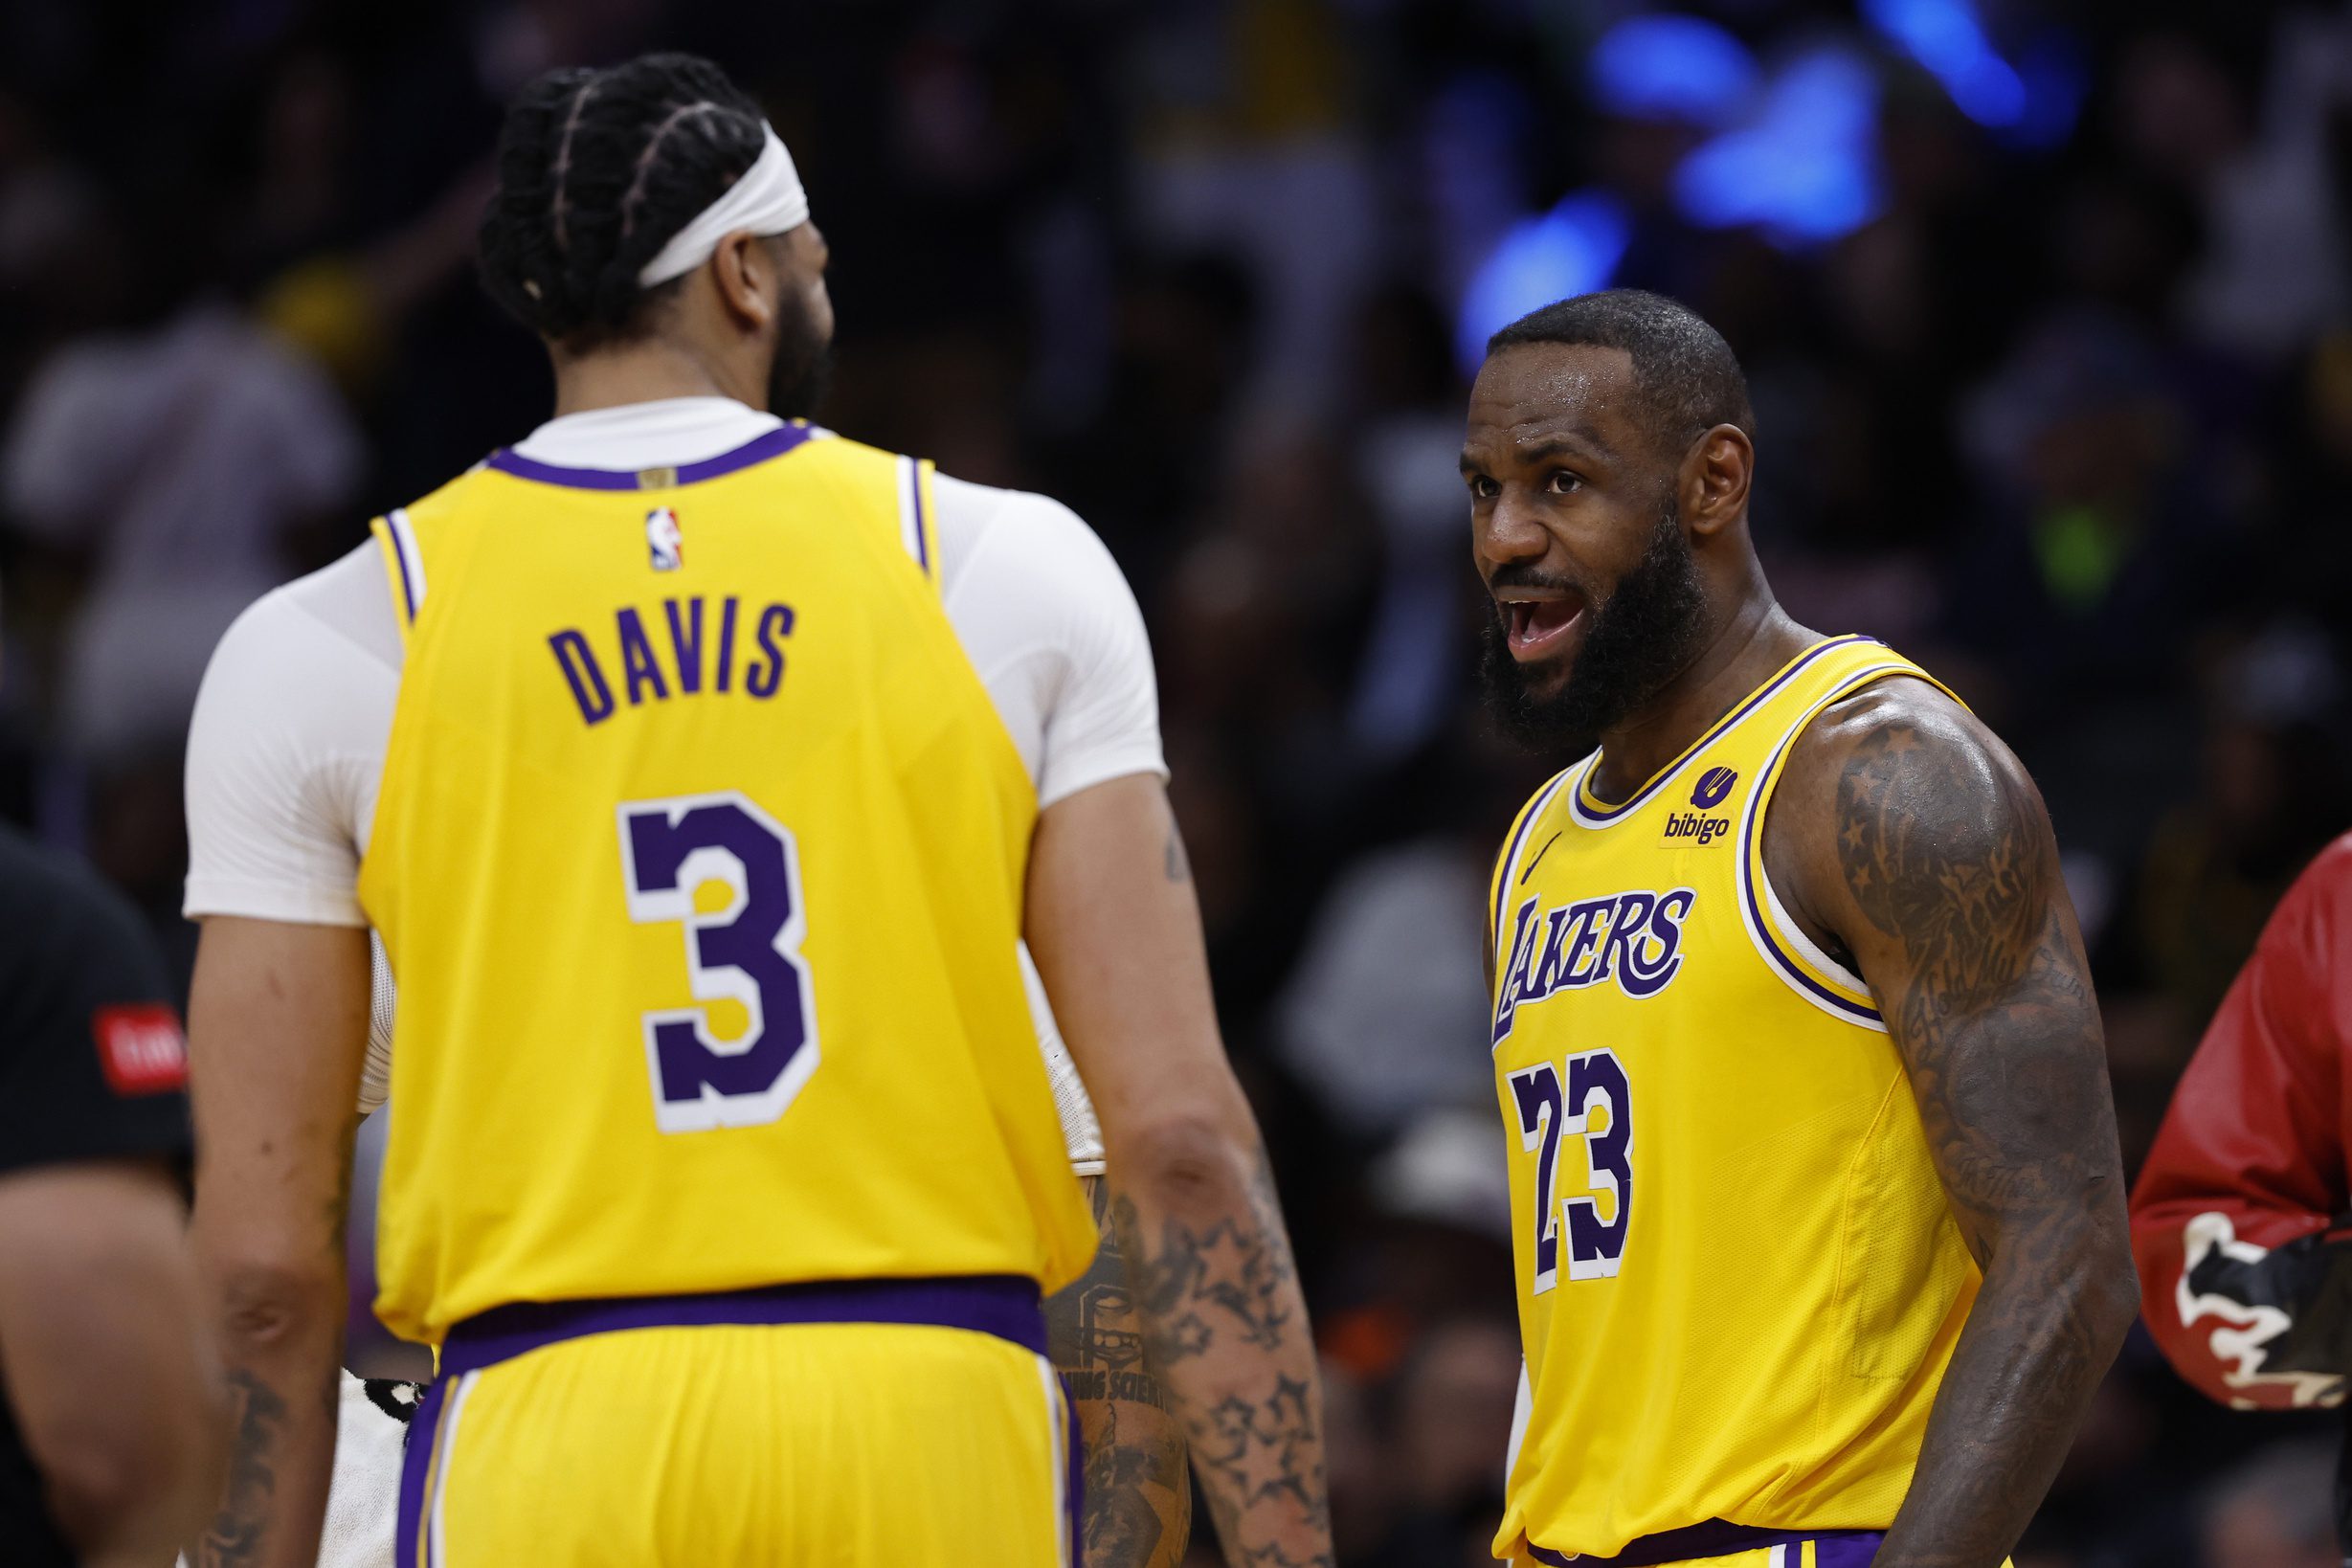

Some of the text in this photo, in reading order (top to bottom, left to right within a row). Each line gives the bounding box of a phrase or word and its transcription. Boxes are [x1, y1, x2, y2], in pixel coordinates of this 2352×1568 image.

[548, 595, 795, 728] DAVIS
[1664, 813, 1730, 845] bibigo
[615, 789, 821, 1135] 3
[1491, 886, 1697, 1052] LAKERS
[1506, 1047, 1634, 1296] 23
